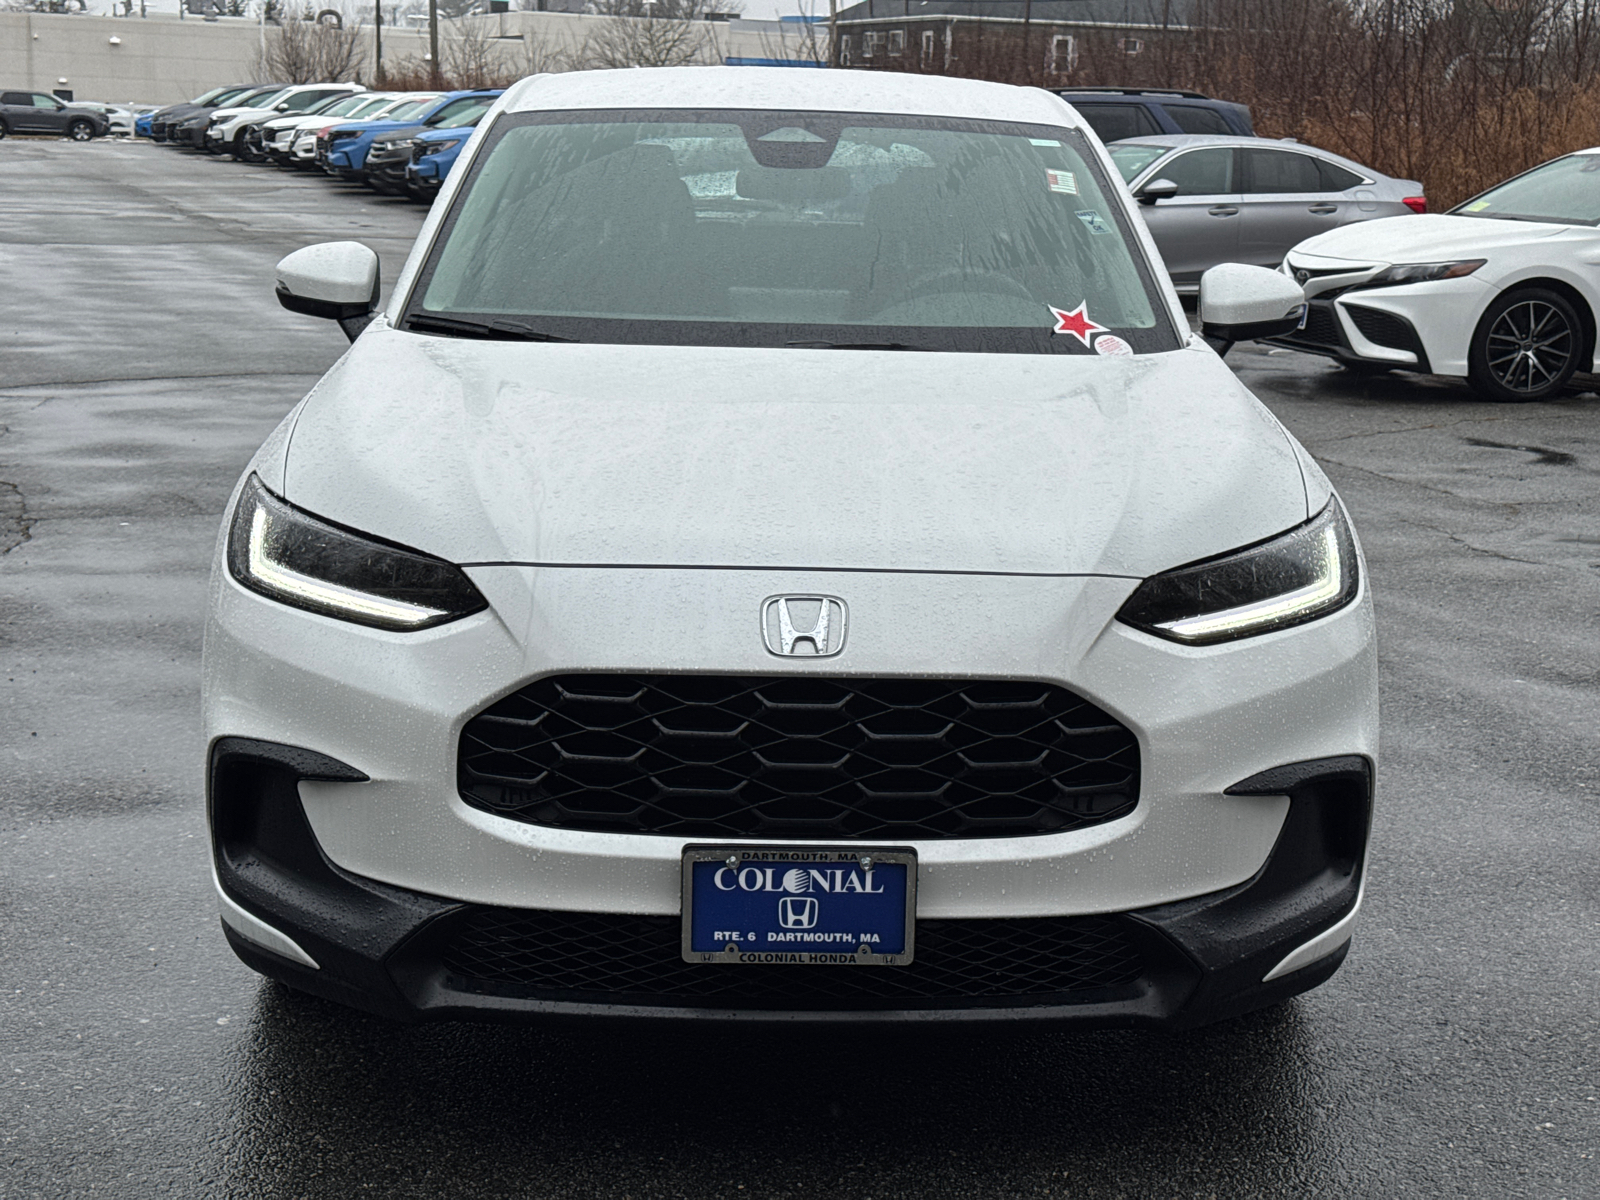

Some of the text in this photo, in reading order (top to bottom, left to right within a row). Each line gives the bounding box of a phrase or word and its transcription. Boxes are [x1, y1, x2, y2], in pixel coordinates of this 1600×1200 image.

[742, 851, 858, 861] DARTMOUTH, MA
[714, 867, 884, 893] COLONIAL
[714, 931, 880, 944] RTE. 6 DARTMOUTH, MA
[739, 953, 857, 964] COLONIAL HONDA
